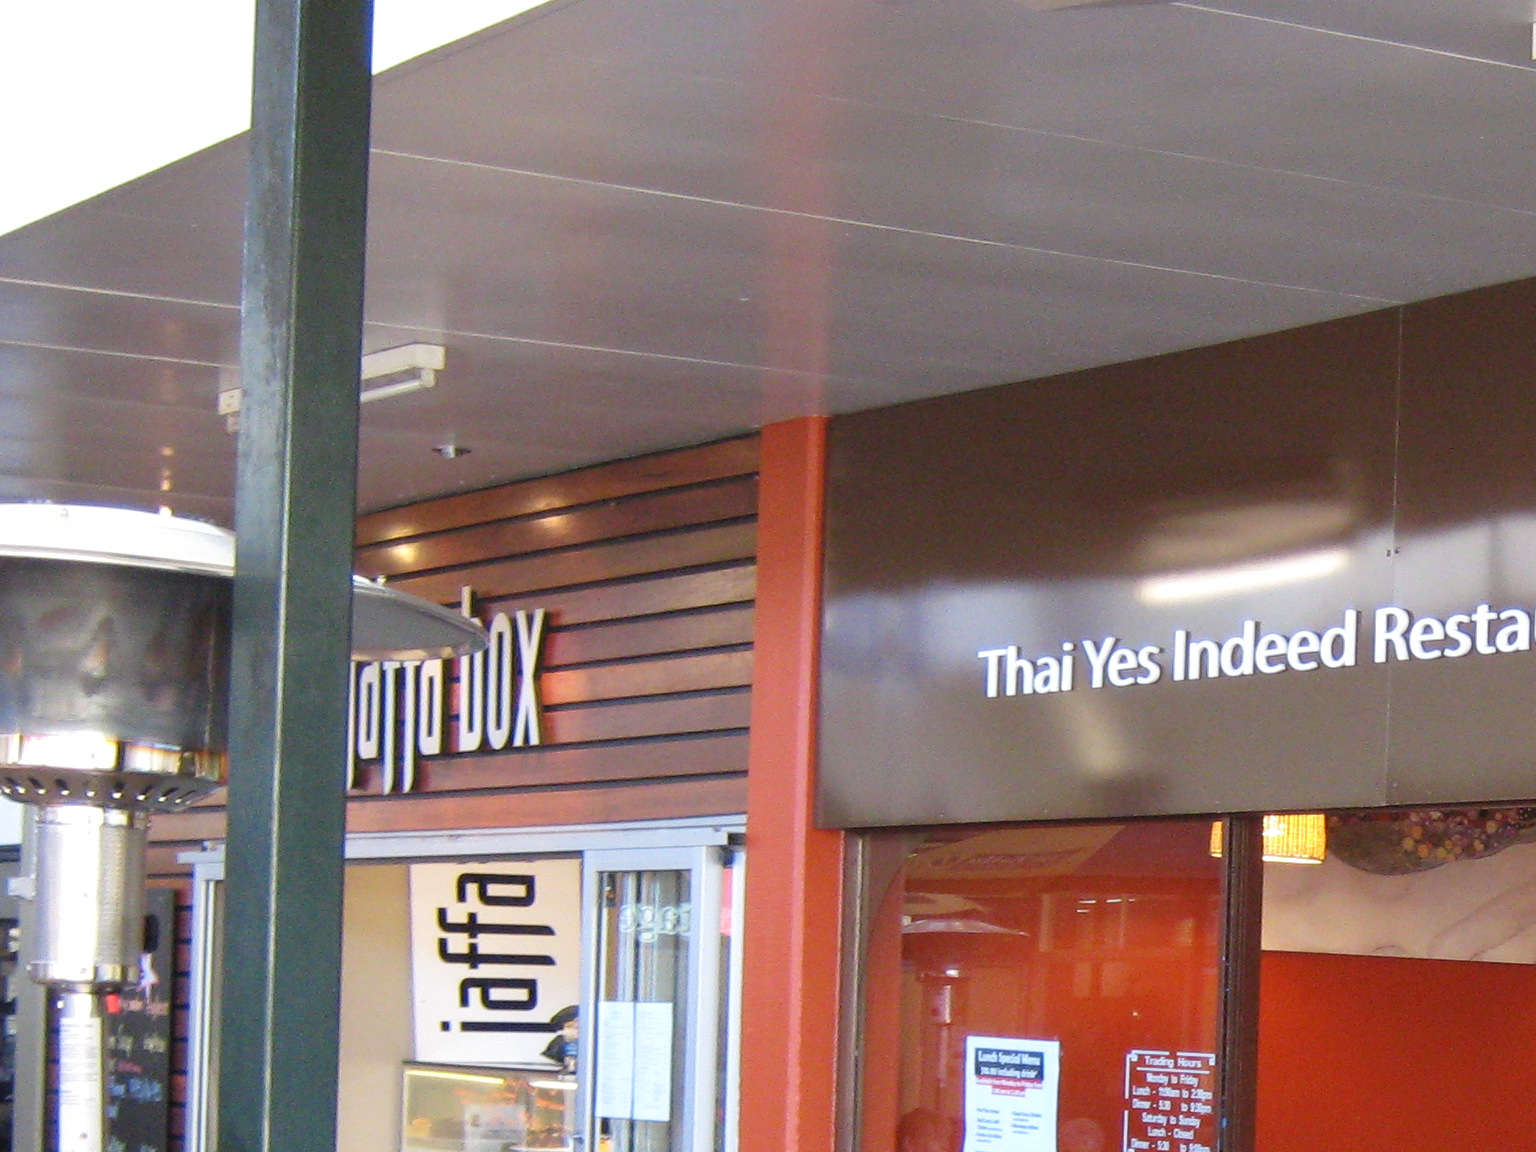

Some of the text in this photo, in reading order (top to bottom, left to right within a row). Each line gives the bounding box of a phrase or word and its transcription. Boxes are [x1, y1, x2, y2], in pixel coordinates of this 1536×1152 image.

[977, 641, 1077, 699] Thai
[1081, 635, 1162, 690] Yes
[1172, 608, 1361, 683] Indeed
[437, 872, 557, 1033] jaffa
[1144, 1056, 1202, 1068] Trading Hours
